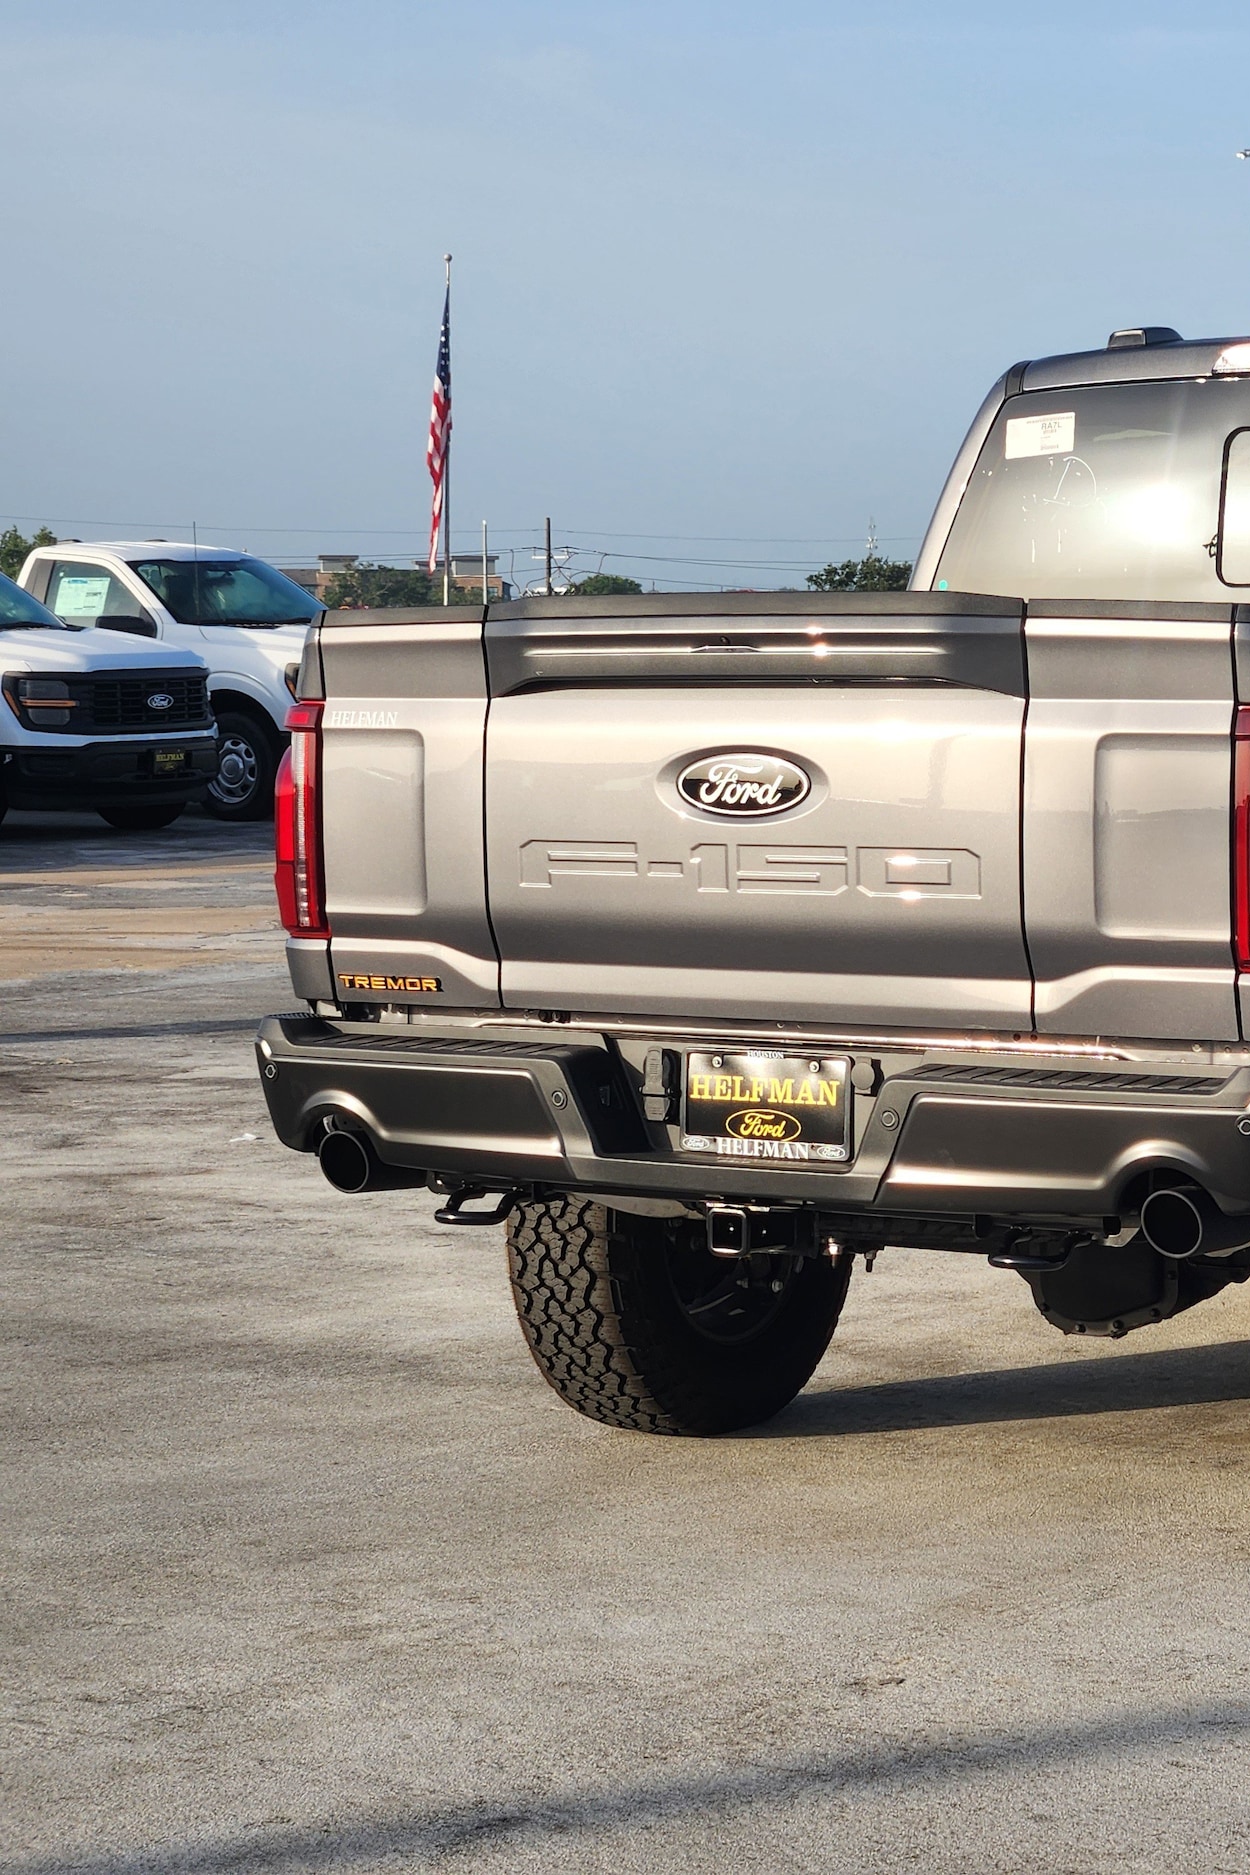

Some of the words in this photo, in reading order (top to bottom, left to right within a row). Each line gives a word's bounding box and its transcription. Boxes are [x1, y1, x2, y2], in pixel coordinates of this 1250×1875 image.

[330, 711, 398, 727] HELFMAN
[699, 763, 784, 805] Ford
[518, 838, 982, 900] F-150
[338, 974, 440, 992] TREMOR
[689, 1074, 840, 1106] HELFMAN
[739, 1112, 787, 1138] Ford
[716, 1137, 810, 1160] HELFMAN
